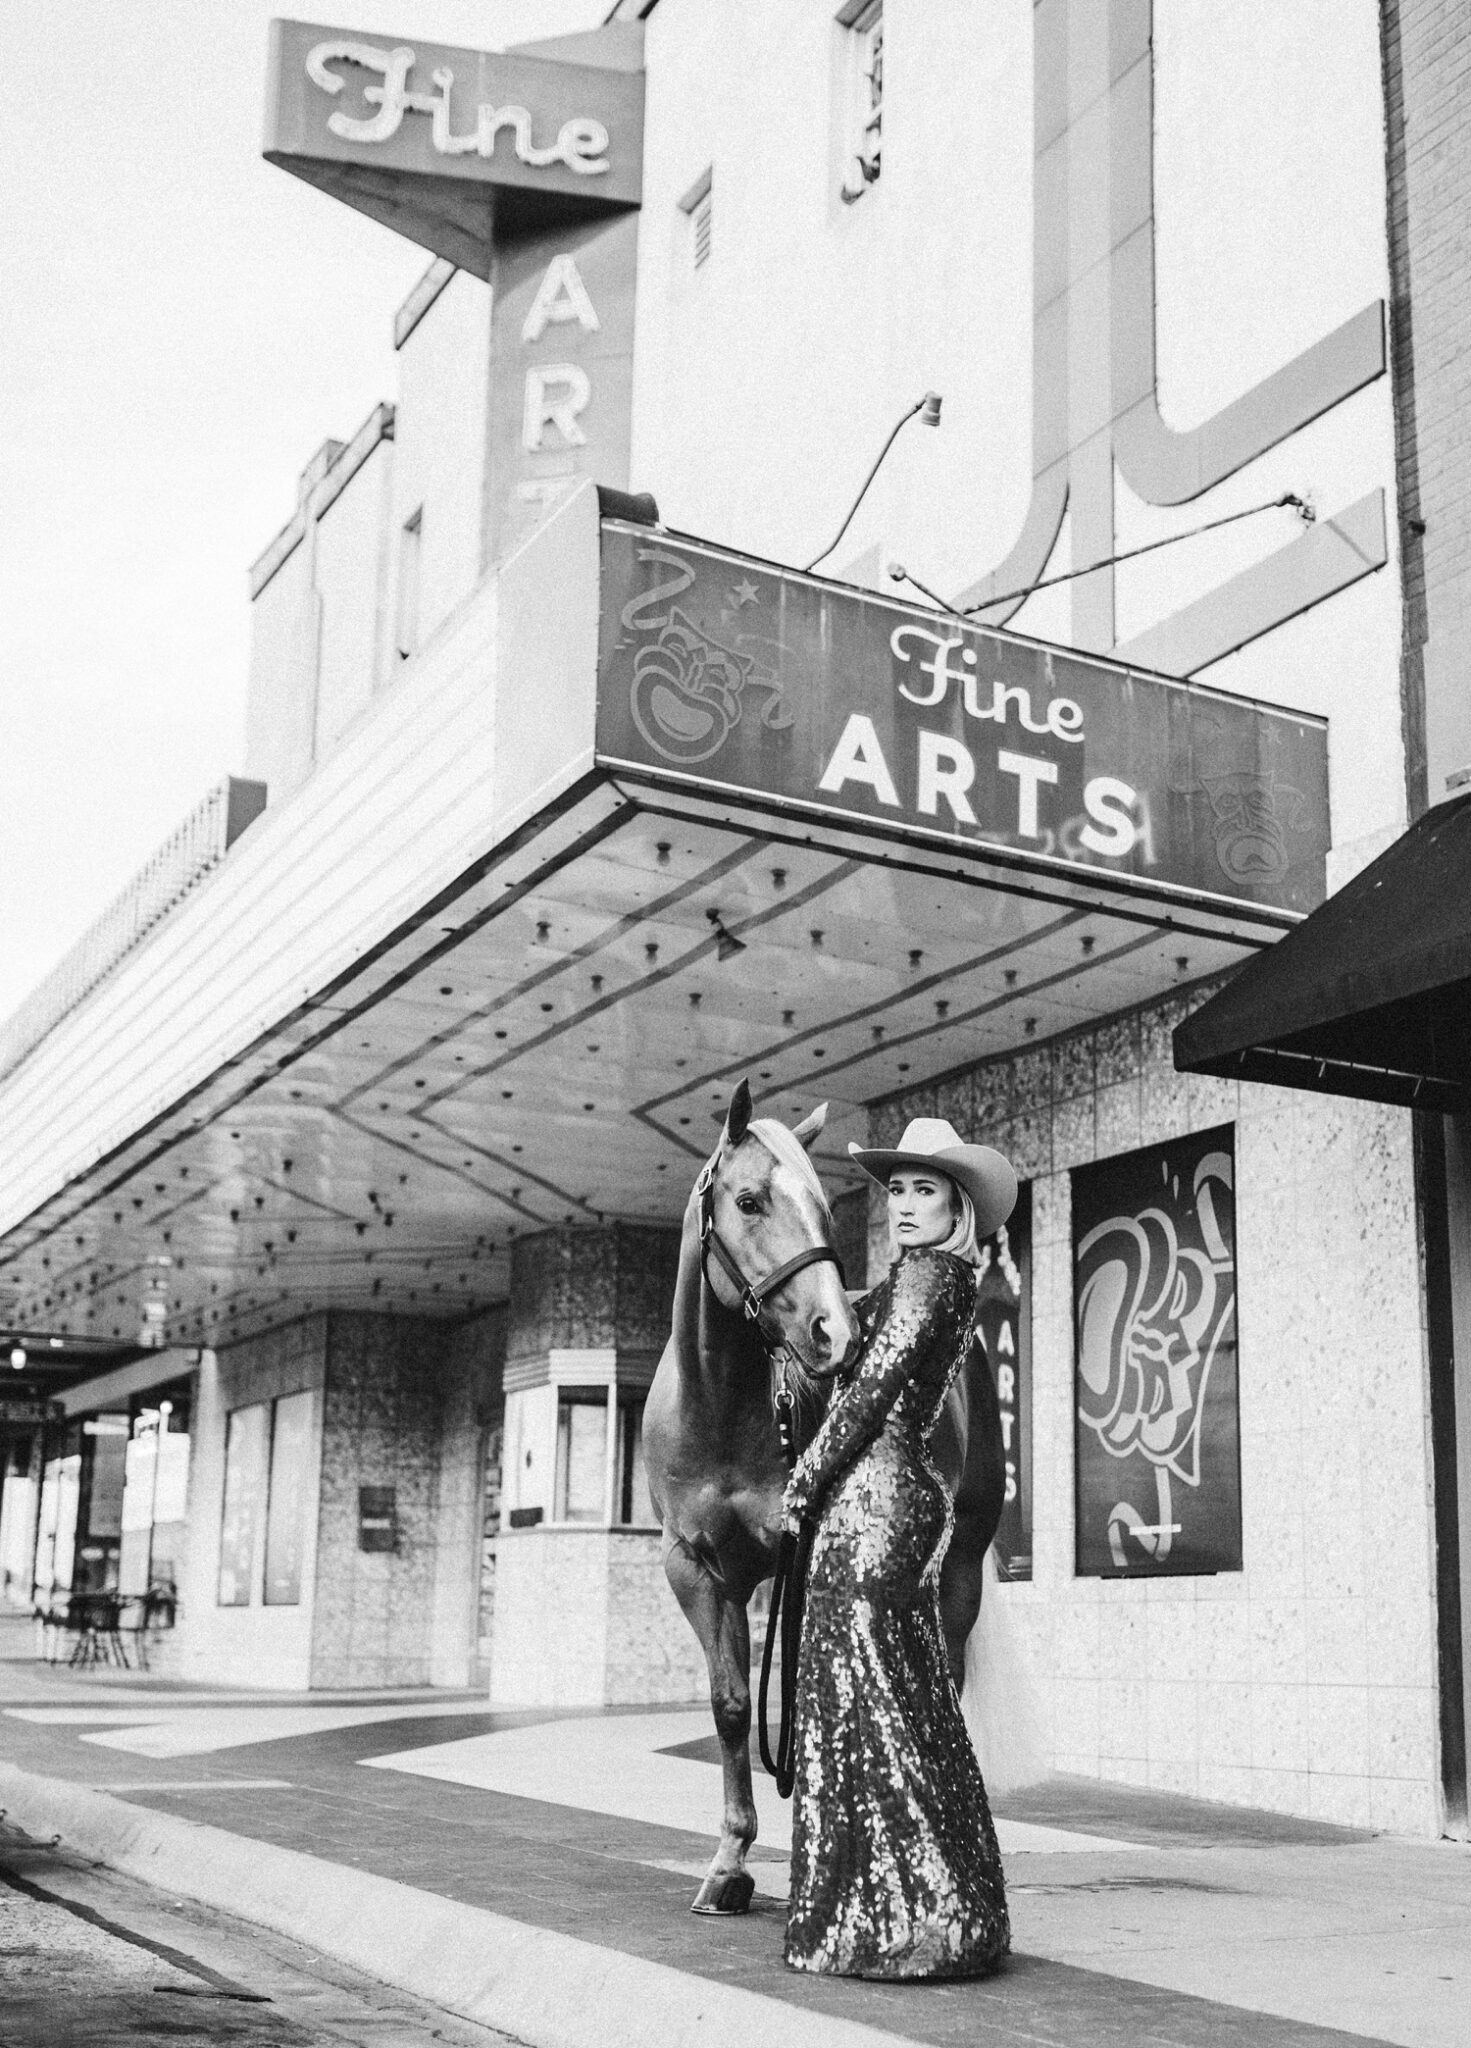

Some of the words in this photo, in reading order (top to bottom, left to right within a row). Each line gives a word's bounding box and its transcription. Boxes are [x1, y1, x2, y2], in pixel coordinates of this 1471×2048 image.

[306, 40, 610, 174] Fine
[890, 625, 1085, 743] Fine
[816, 713, 1137, 857] ARTS
